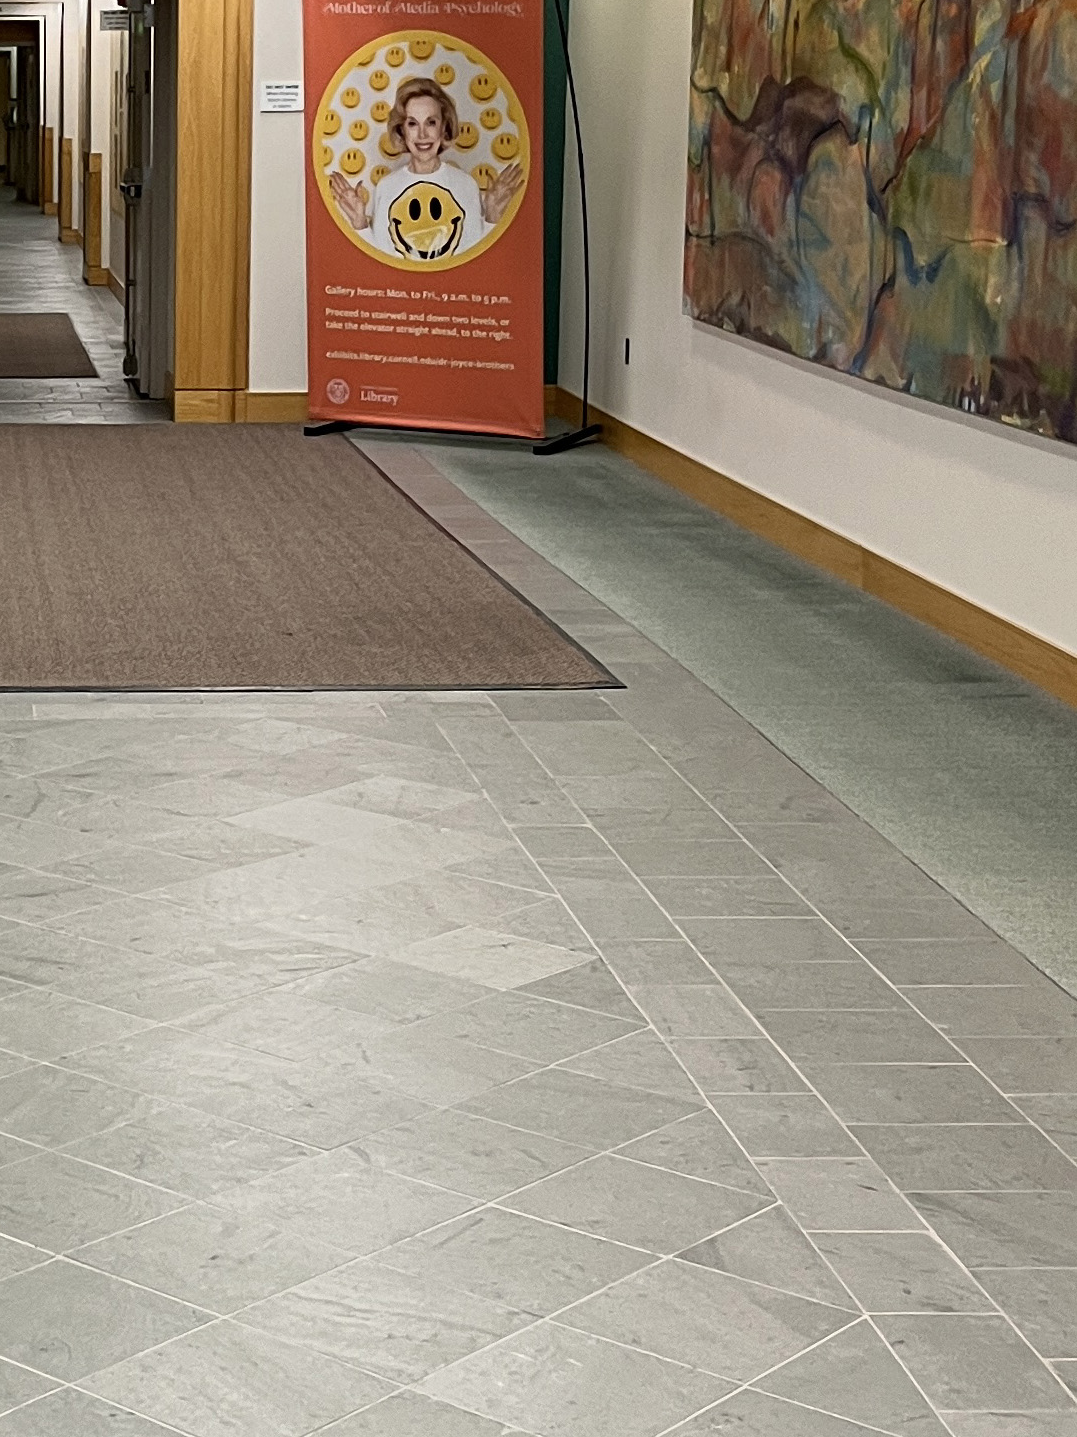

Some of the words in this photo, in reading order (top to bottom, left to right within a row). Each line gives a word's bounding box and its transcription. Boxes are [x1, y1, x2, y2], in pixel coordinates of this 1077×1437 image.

[323, 1, 376, 14] Mother
[377, 1, 392, 13] of
[393, 1, 439, 14] Media
[443, 1, 525, 17] Psychology
[325, 285, 355, 297] Gallery
[387, 289, 409, 298] Mon.
[411, 291, 420, 299] to
[442, 293, 448, 302] 9
[471, 294, 481, 302] to
[325, 308, 359, 317] Proceed
[360, 310, 370, 318] to
[371, 312, 407, 320] stairwell
[409, 313, 424, 321] and
[426, 314, 450, 322] down
[452, 316, 469, 324] two
[325, 321, 343, 329] take
[344, 321, 358, 330] the
[360, 323, 394, 332] elevator
[396, 325, 429, 336] straight
[461, 329, 470, 337] to
[472, 329, 487, 337] the
[360, 390, 399, 406] Library
